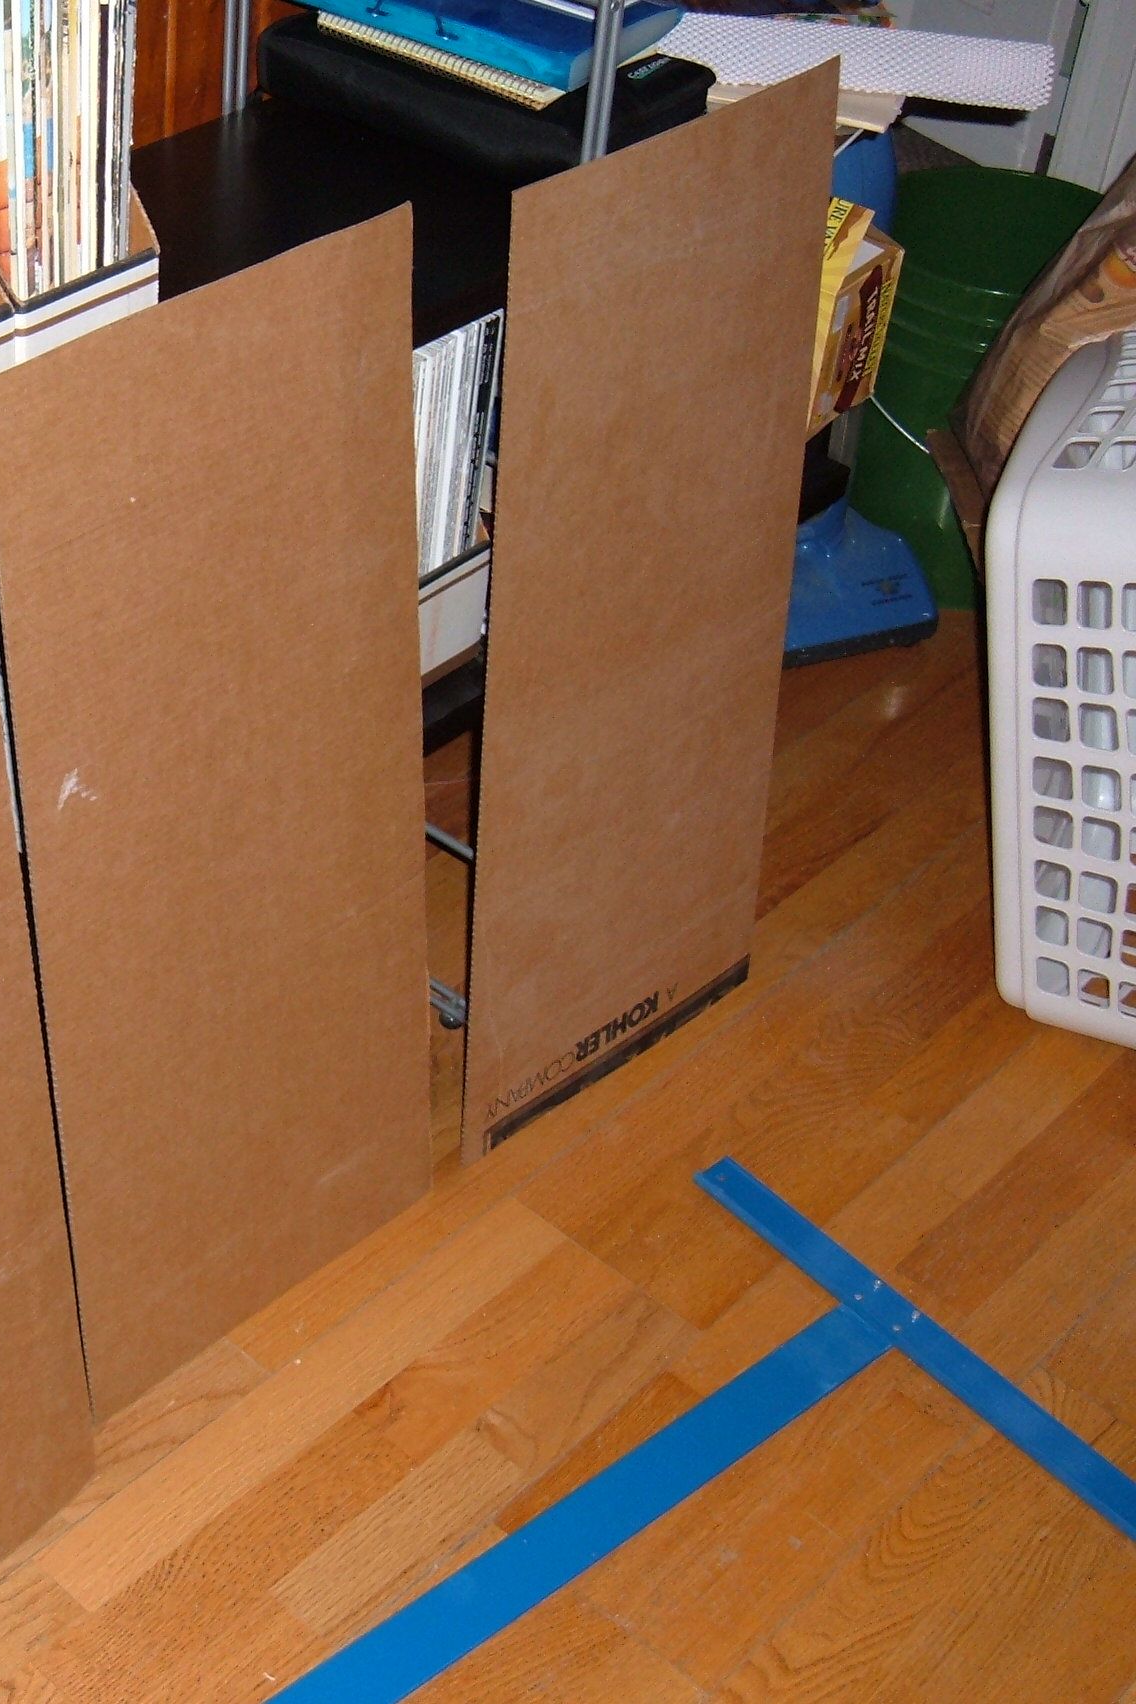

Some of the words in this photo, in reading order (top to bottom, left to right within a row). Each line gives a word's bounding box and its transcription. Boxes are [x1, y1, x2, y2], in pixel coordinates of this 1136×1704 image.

[575, 990, 660, 1062] KOHLER
[665, 982, 679, 1002] A
[485, 1050, 577, 1120] COMPANY
